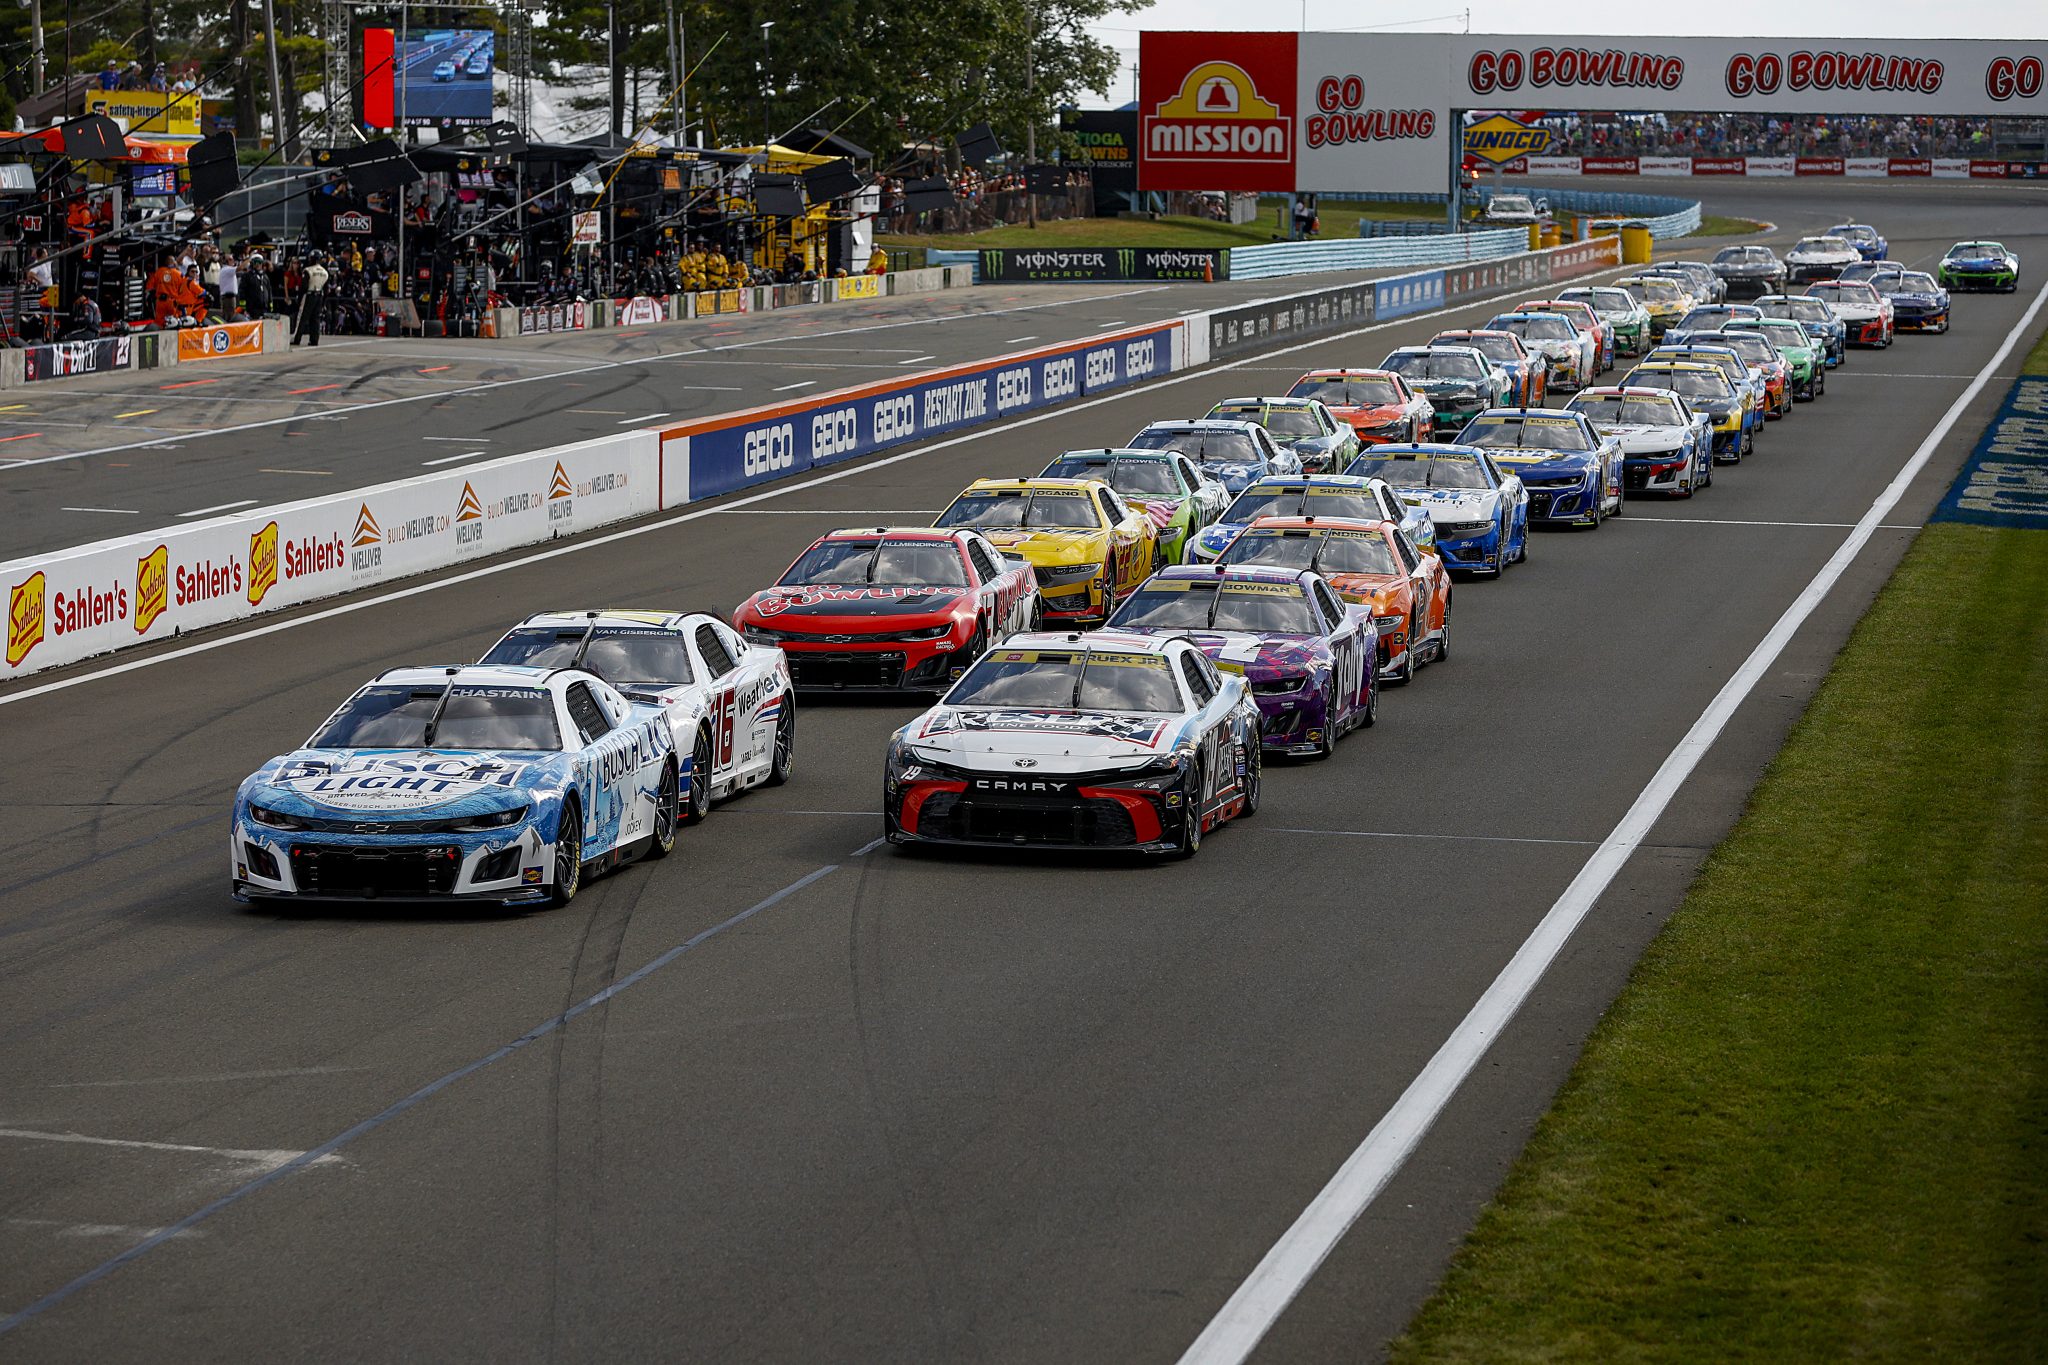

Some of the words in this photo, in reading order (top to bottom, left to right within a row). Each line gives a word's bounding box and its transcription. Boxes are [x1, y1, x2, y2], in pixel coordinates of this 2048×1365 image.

[1469, 50, 1525, 94] GO
[1530, 47, 1684, 90] BOWLING
[1725, 52, 1782, 97] GO
[1788, 50, 1944, 94] BOWLING
[1986, 56, 2044, 101] GO
[1316, 74, 1364, 113] GO
[1152, 125, 1283, 153] MISSION
[1304, 109, 1436, 149] BOWLING
[1029, 270, 1093, 278] ENERGY
[116, 336, 130, 366] 23
[1086, 348, 1115, 388] GEICO
[1126, 339, 1154, 378] GEICO
[997, 367, 1031, 411] GEICO
[1043, 358, 1075, 399] GEICO
[873, 394, 914, 443] GEICO
[923, 382, 964, 430] RESTART
[964, 378, 988, 419] ZONE
[744, 422, 793, 477] GEICO
[812, 407, 857, 459] GEICO
[456, 522, 482, 545] WELLIVER
[285, 532, 344, 579] Sahlen's
[351, 547, 381, 571] WELLIVER
[138, 562, 165, 615] Sahlen's
[176, 554, 242, 606] Sahlen's
[1223, 584, 1290, 593] BOWMAN
[11, 589, 42, 647] Sahlen's
[54, 580, 127, 635] Sahlen's
[755, 587, 967, 616] BOWLING
[1074, 654, 1131, 664] TRUEX
[449, 688, 542, 699] CHASTAIN
[713, 686, 735, 771] 16
[313, 776, 458, 792] LIGHT
[603, 742, 640, 792] BUSCH
[901, 765, 921, 780] 19
[977, 780, 1067, 791] CAMRY
